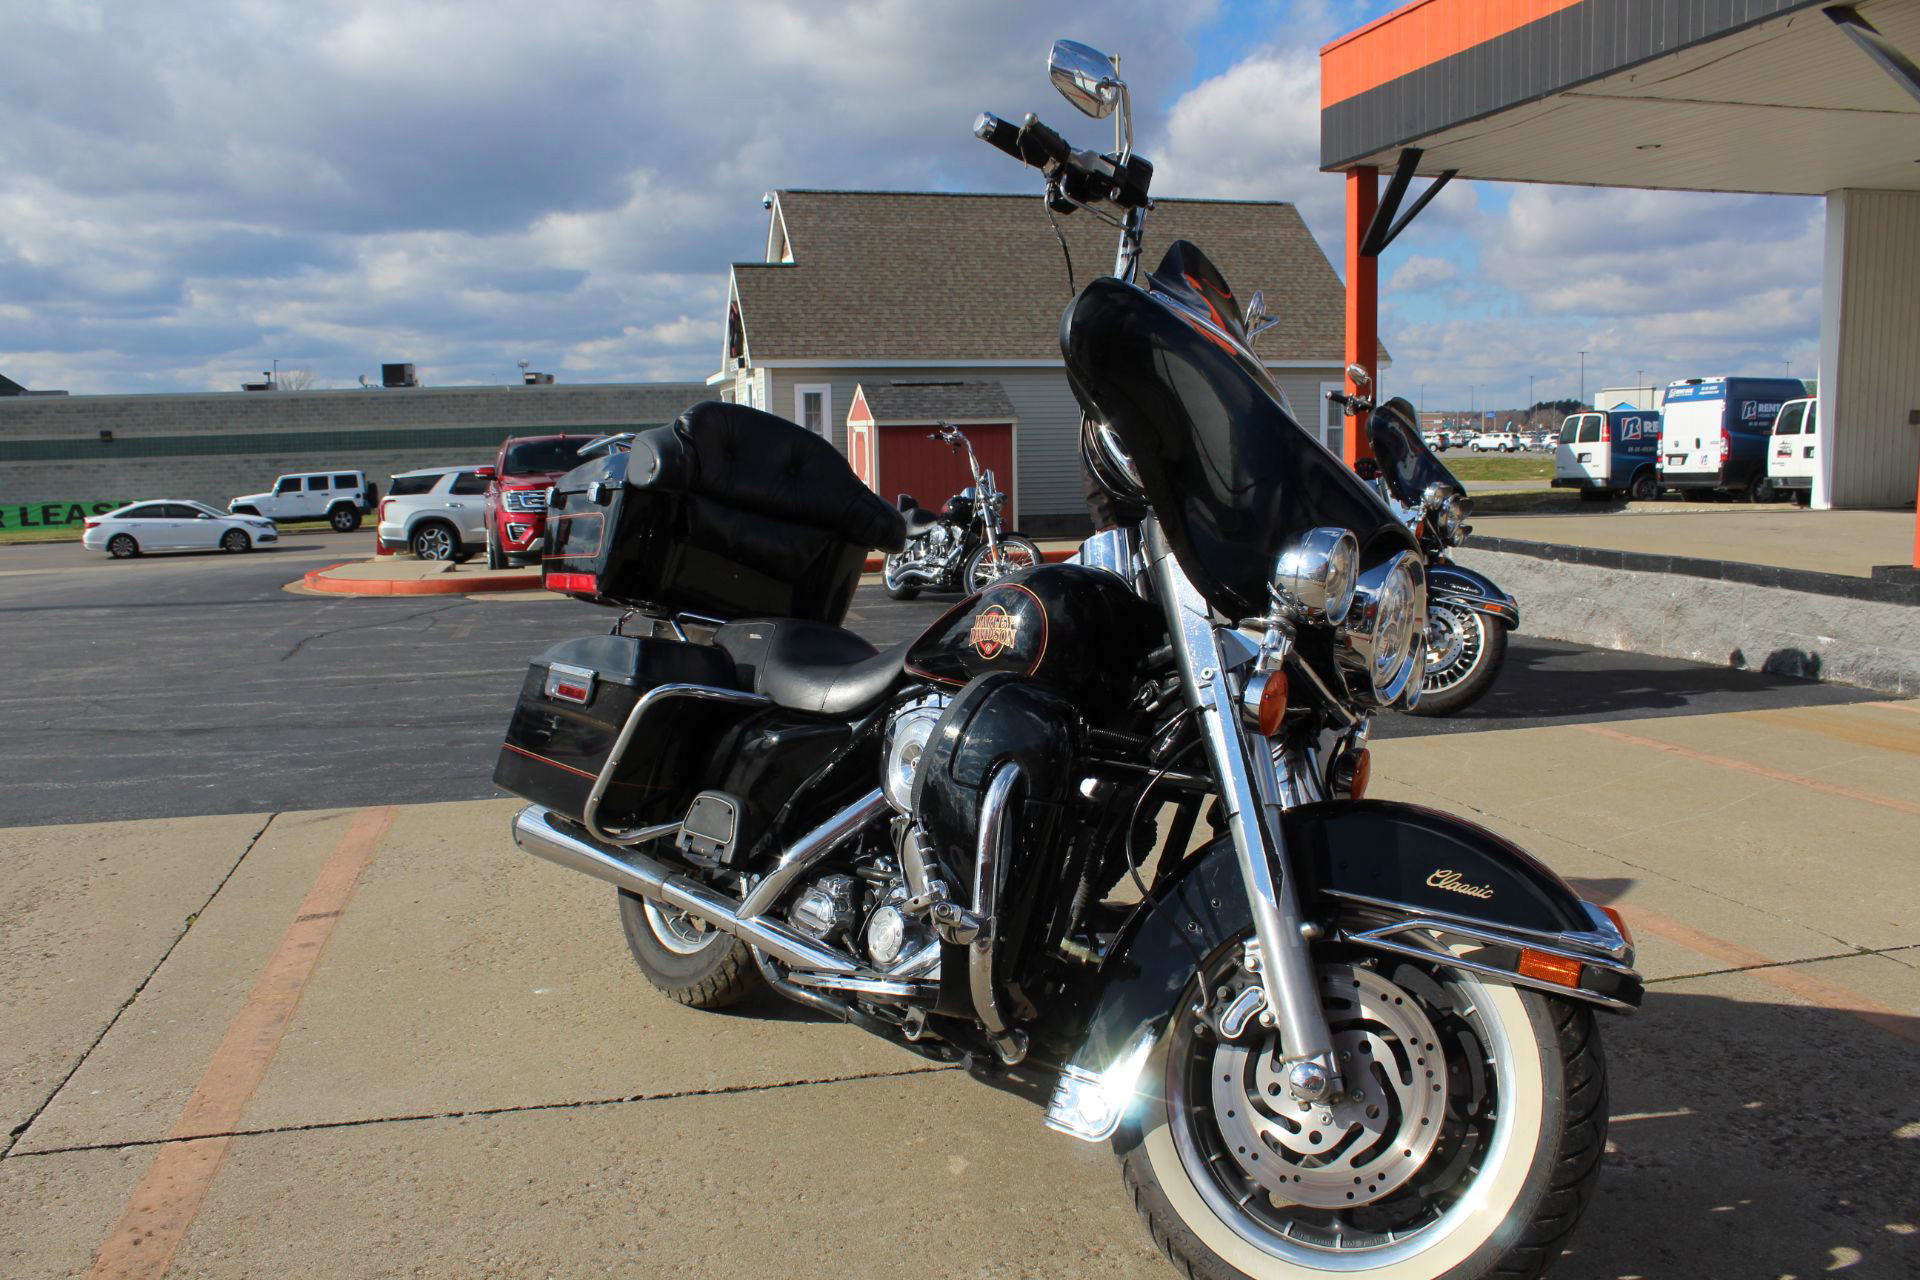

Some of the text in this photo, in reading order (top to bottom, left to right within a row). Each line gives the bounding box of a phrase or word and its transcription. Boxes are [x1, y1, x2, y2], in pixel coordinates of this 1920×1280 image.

[1758, 403, 1781, 412] RENT
[19, 501, 133, 527] LEAS
[968, 627, 1018, 649] DAVIDSON
[1426, 868, 1494, 899] Classic
